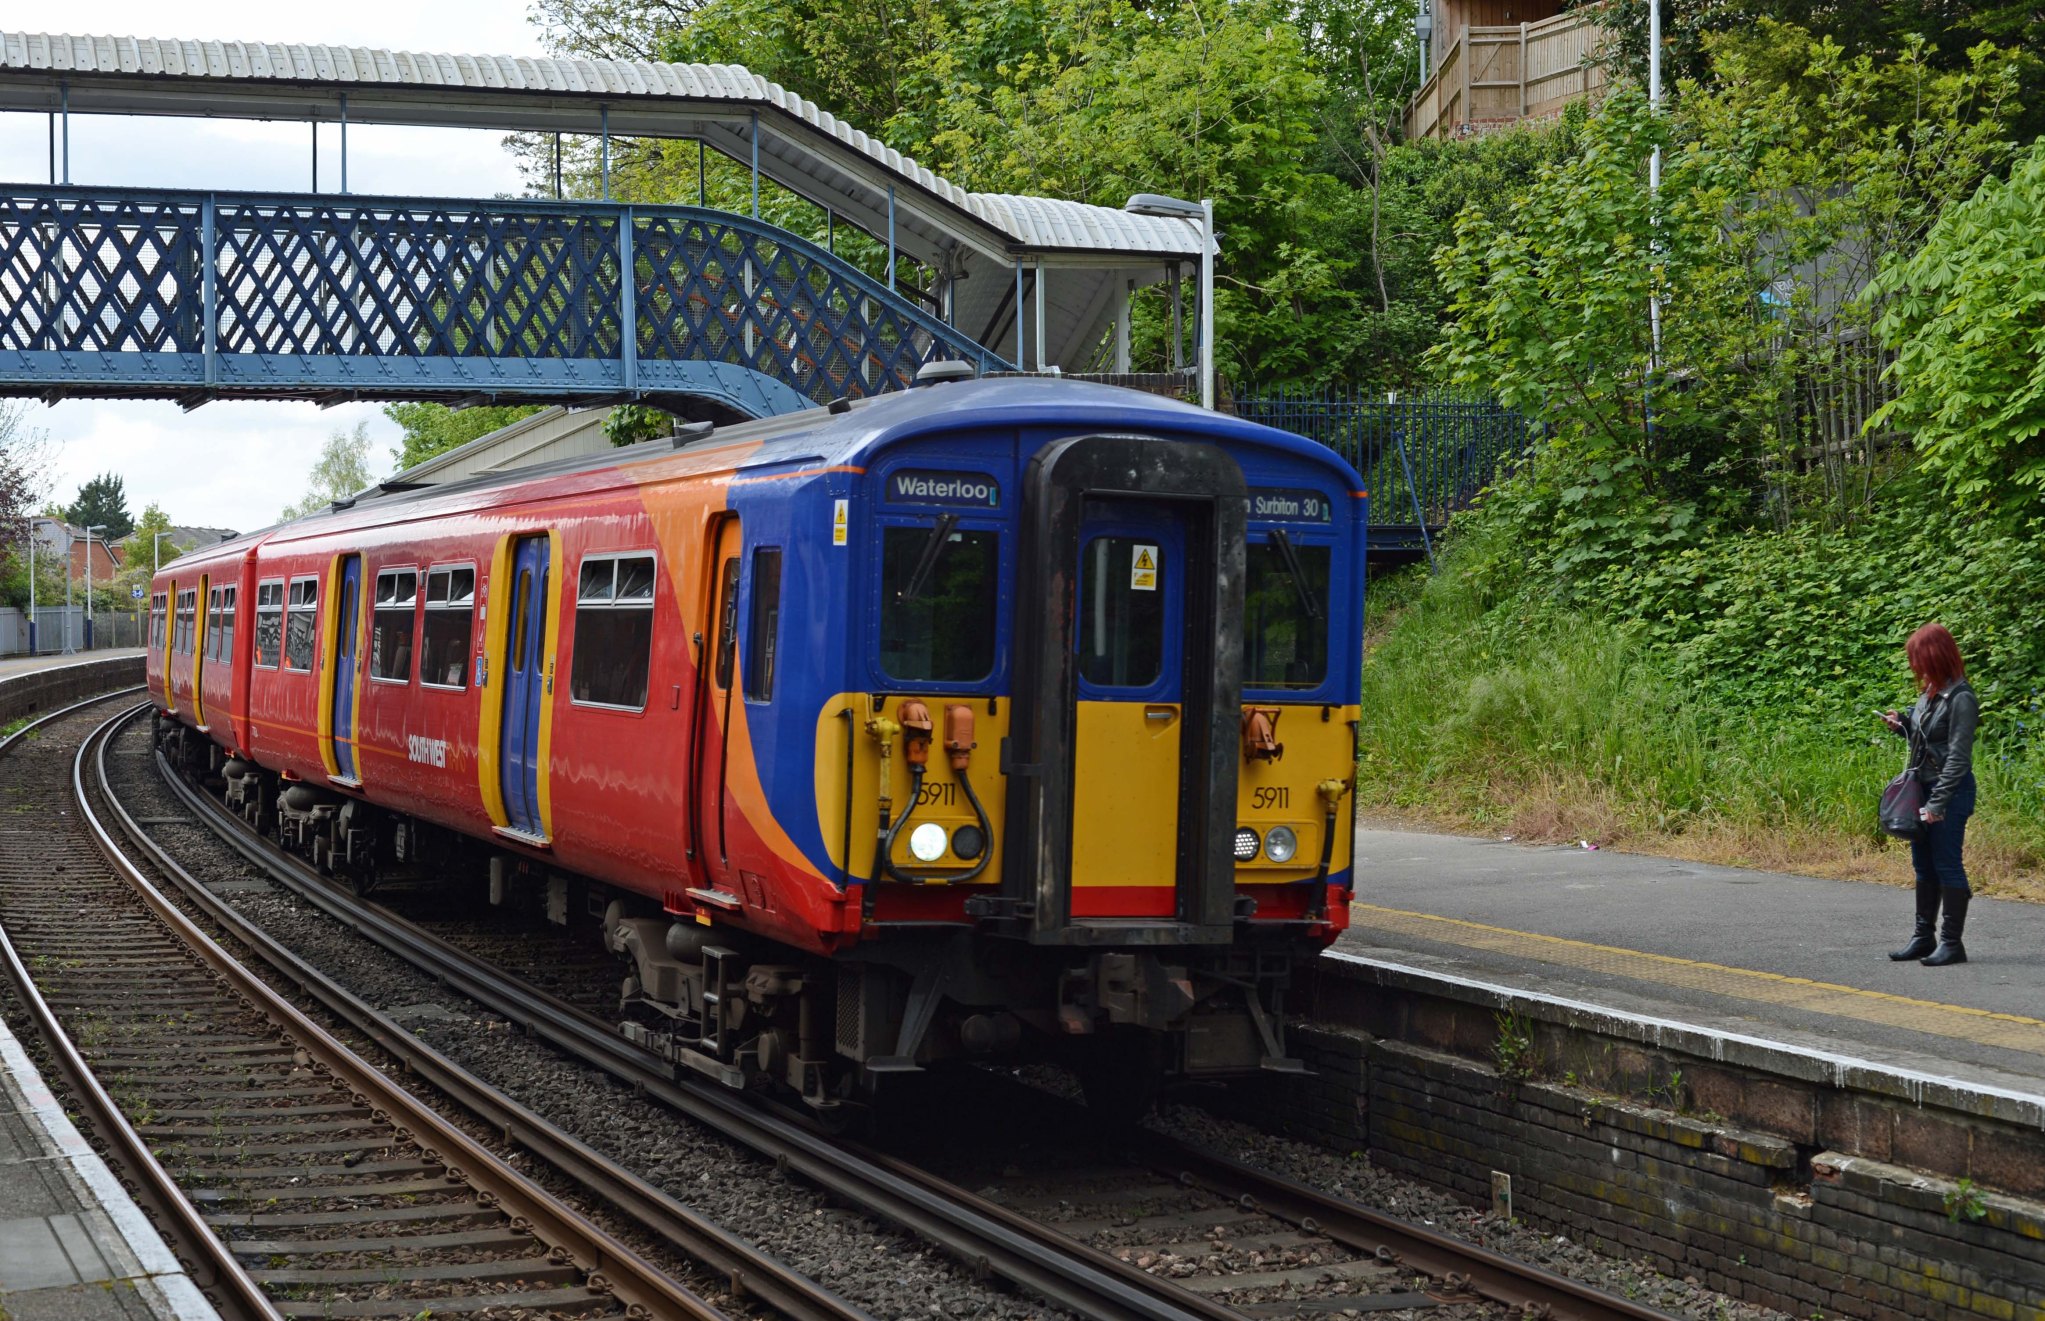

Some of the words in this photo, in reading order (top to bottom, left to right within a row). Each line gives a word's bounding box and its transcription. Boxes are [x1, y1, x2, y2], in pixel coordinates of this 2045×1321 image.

[897, 476, 988, 499] Waterloo
[1255, 496, 1299, 516] Surbiton
[1303, 498, 1319, 517] 30
[408, 733, 430, 765] SOUTH
[429, 737, 447, 769] WEST
[916, 782, 955, 806] 5911
[1251, 786, 1289, 809] 5911
